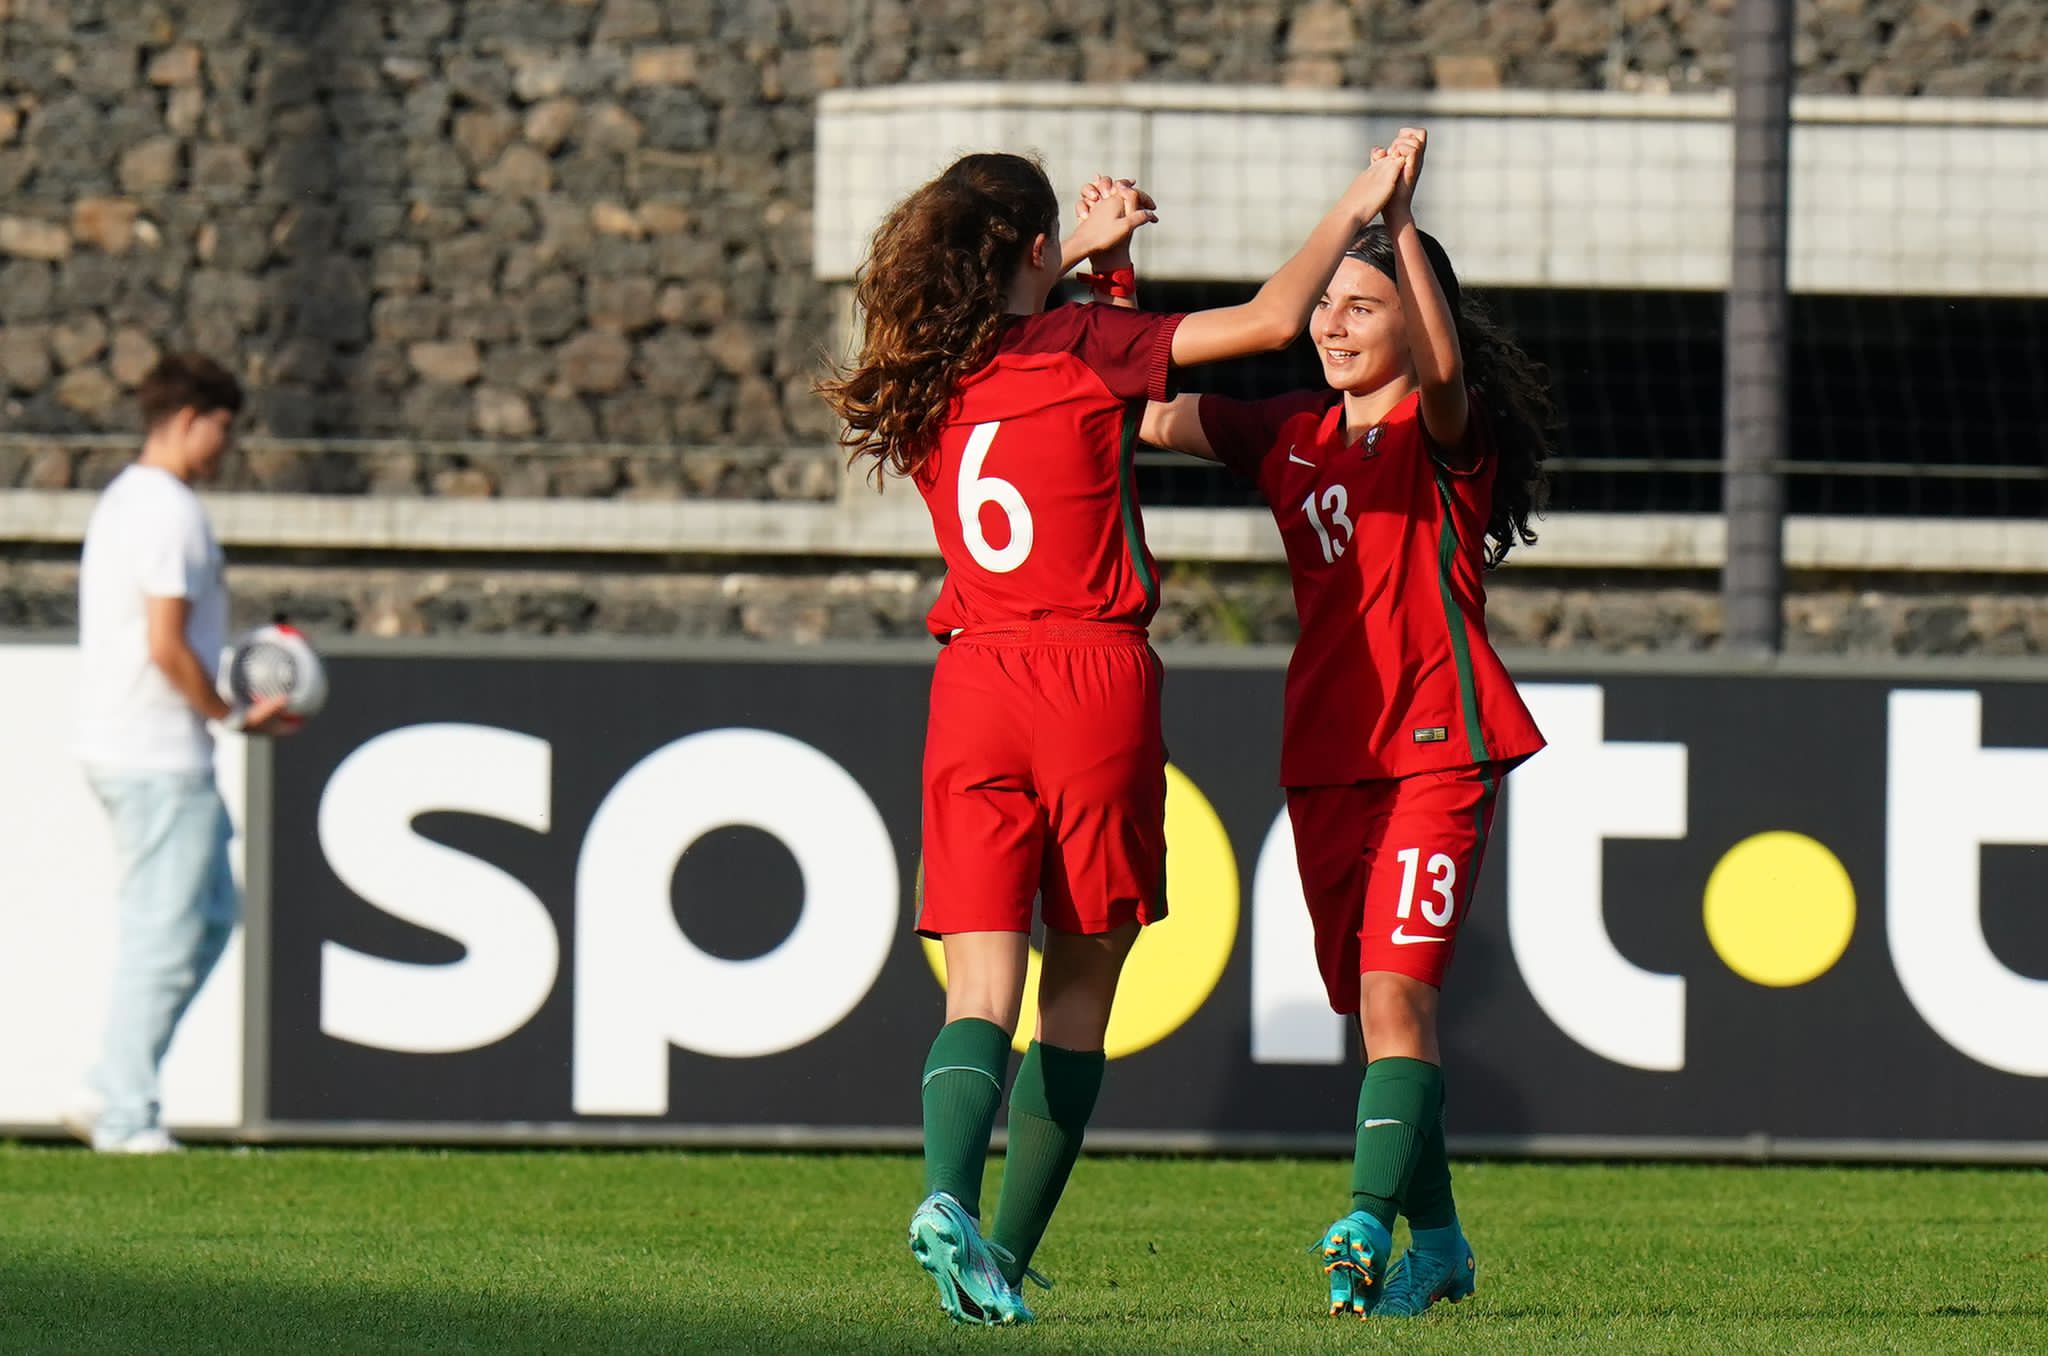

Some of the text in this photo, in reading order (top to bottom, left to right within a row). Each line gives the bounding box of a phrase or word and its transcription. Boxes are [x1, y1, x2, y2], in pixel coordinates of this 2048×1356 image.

[957, 421, 1034, 573] 6
[1301, 484, 1354, 564] 13
[1395, 847, 1457, 928] 13
